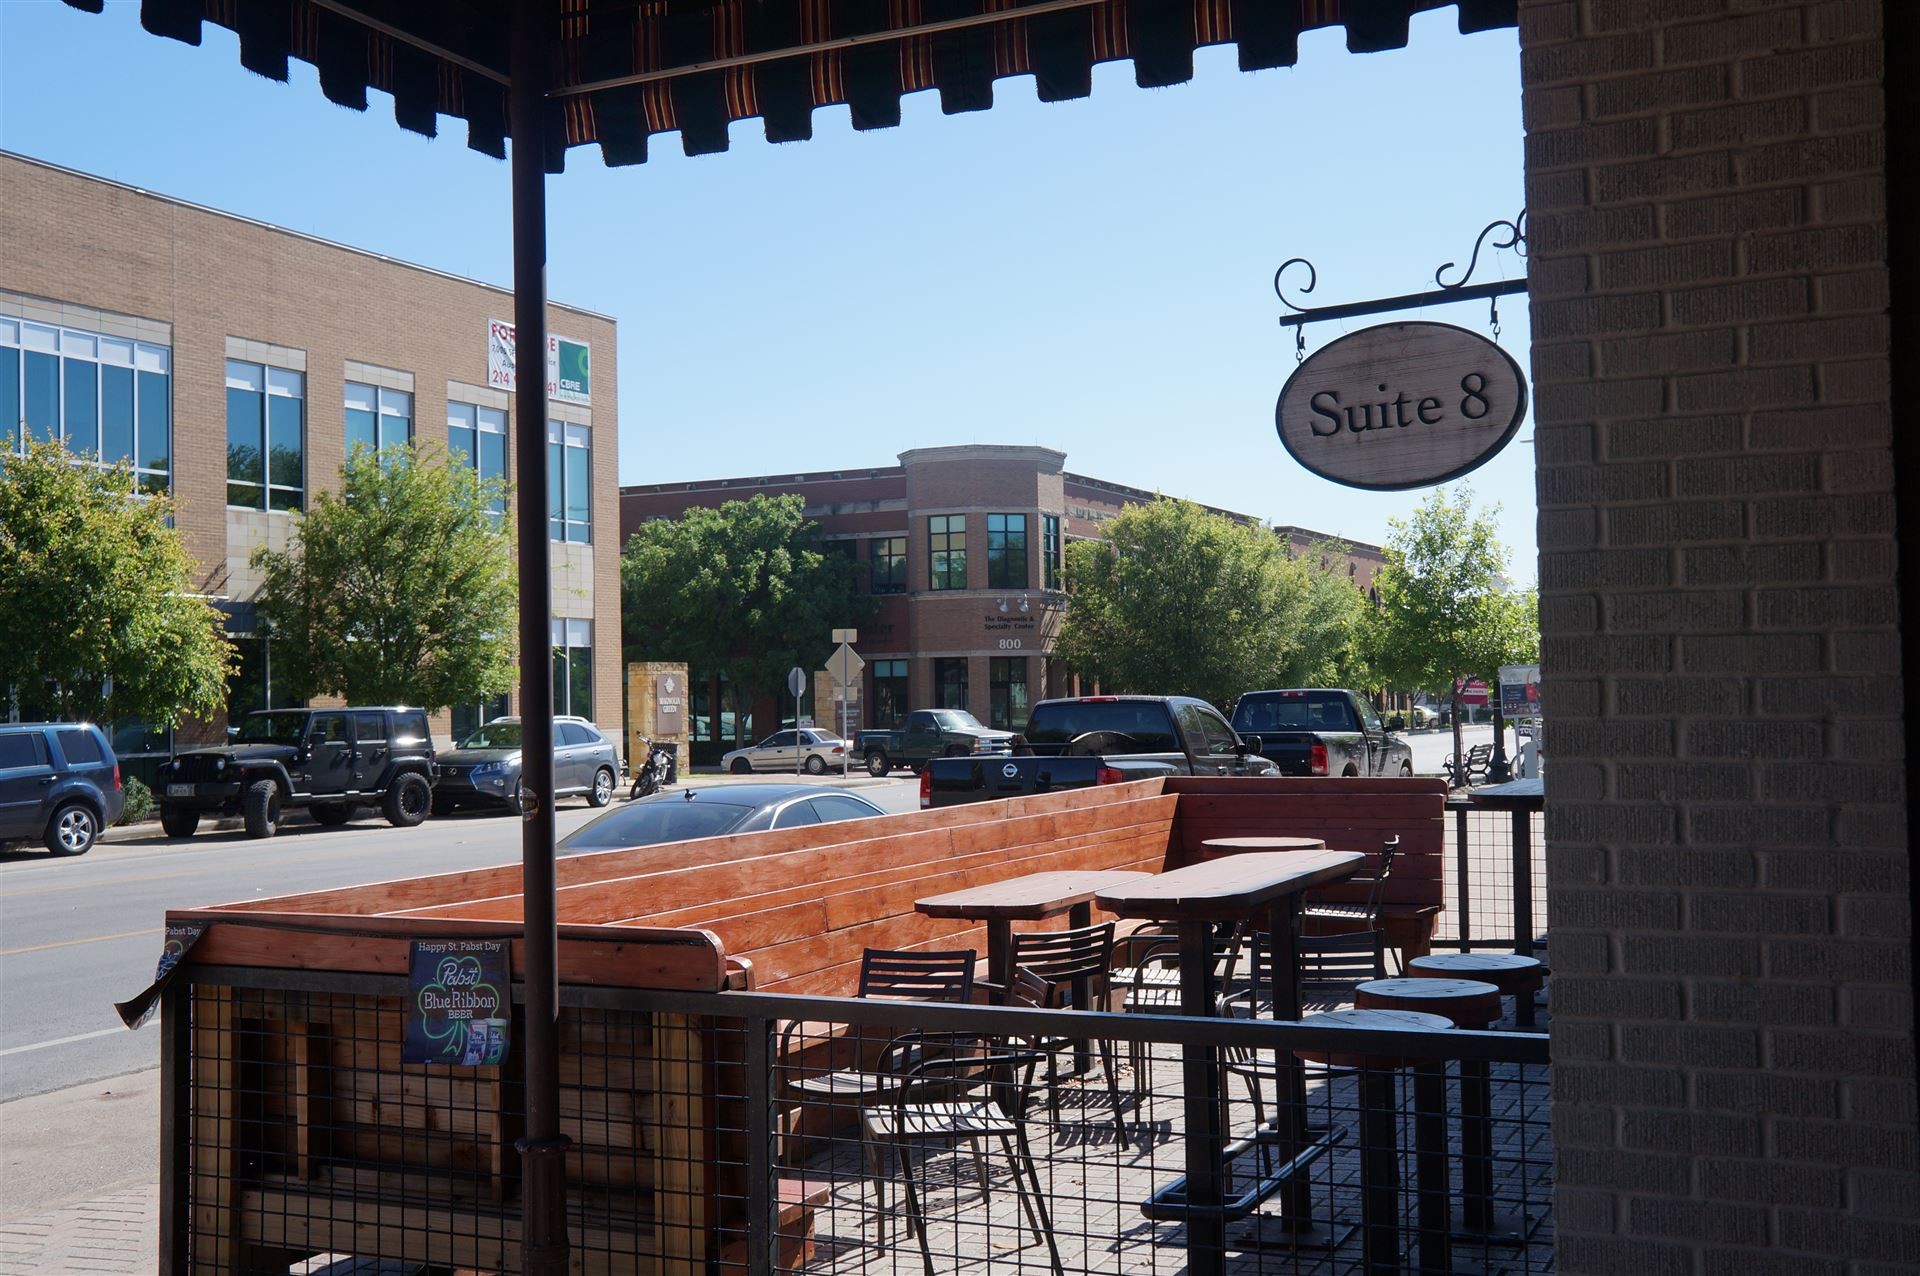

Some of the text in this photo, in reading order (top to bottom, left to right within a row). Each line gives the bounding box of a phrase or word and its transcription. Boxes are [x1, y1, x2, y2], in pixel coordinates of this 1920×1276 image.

[560, 379, 581, 391] CBRE
[1310, 372, 1490, 437] Suite 8
[997, 615, 1027, 623] Diagnostic
[999, 638, 1021, 649] 800
[165, 926, 201, 937] Pabst Day
[418, 941, 501, 953] Happy St. Pabst Day
[442, 962, 478, 985] Pabst
[424, 991, 496, 1009] Blue Ribbon
[448, 1009, 473, 1019] BEER
